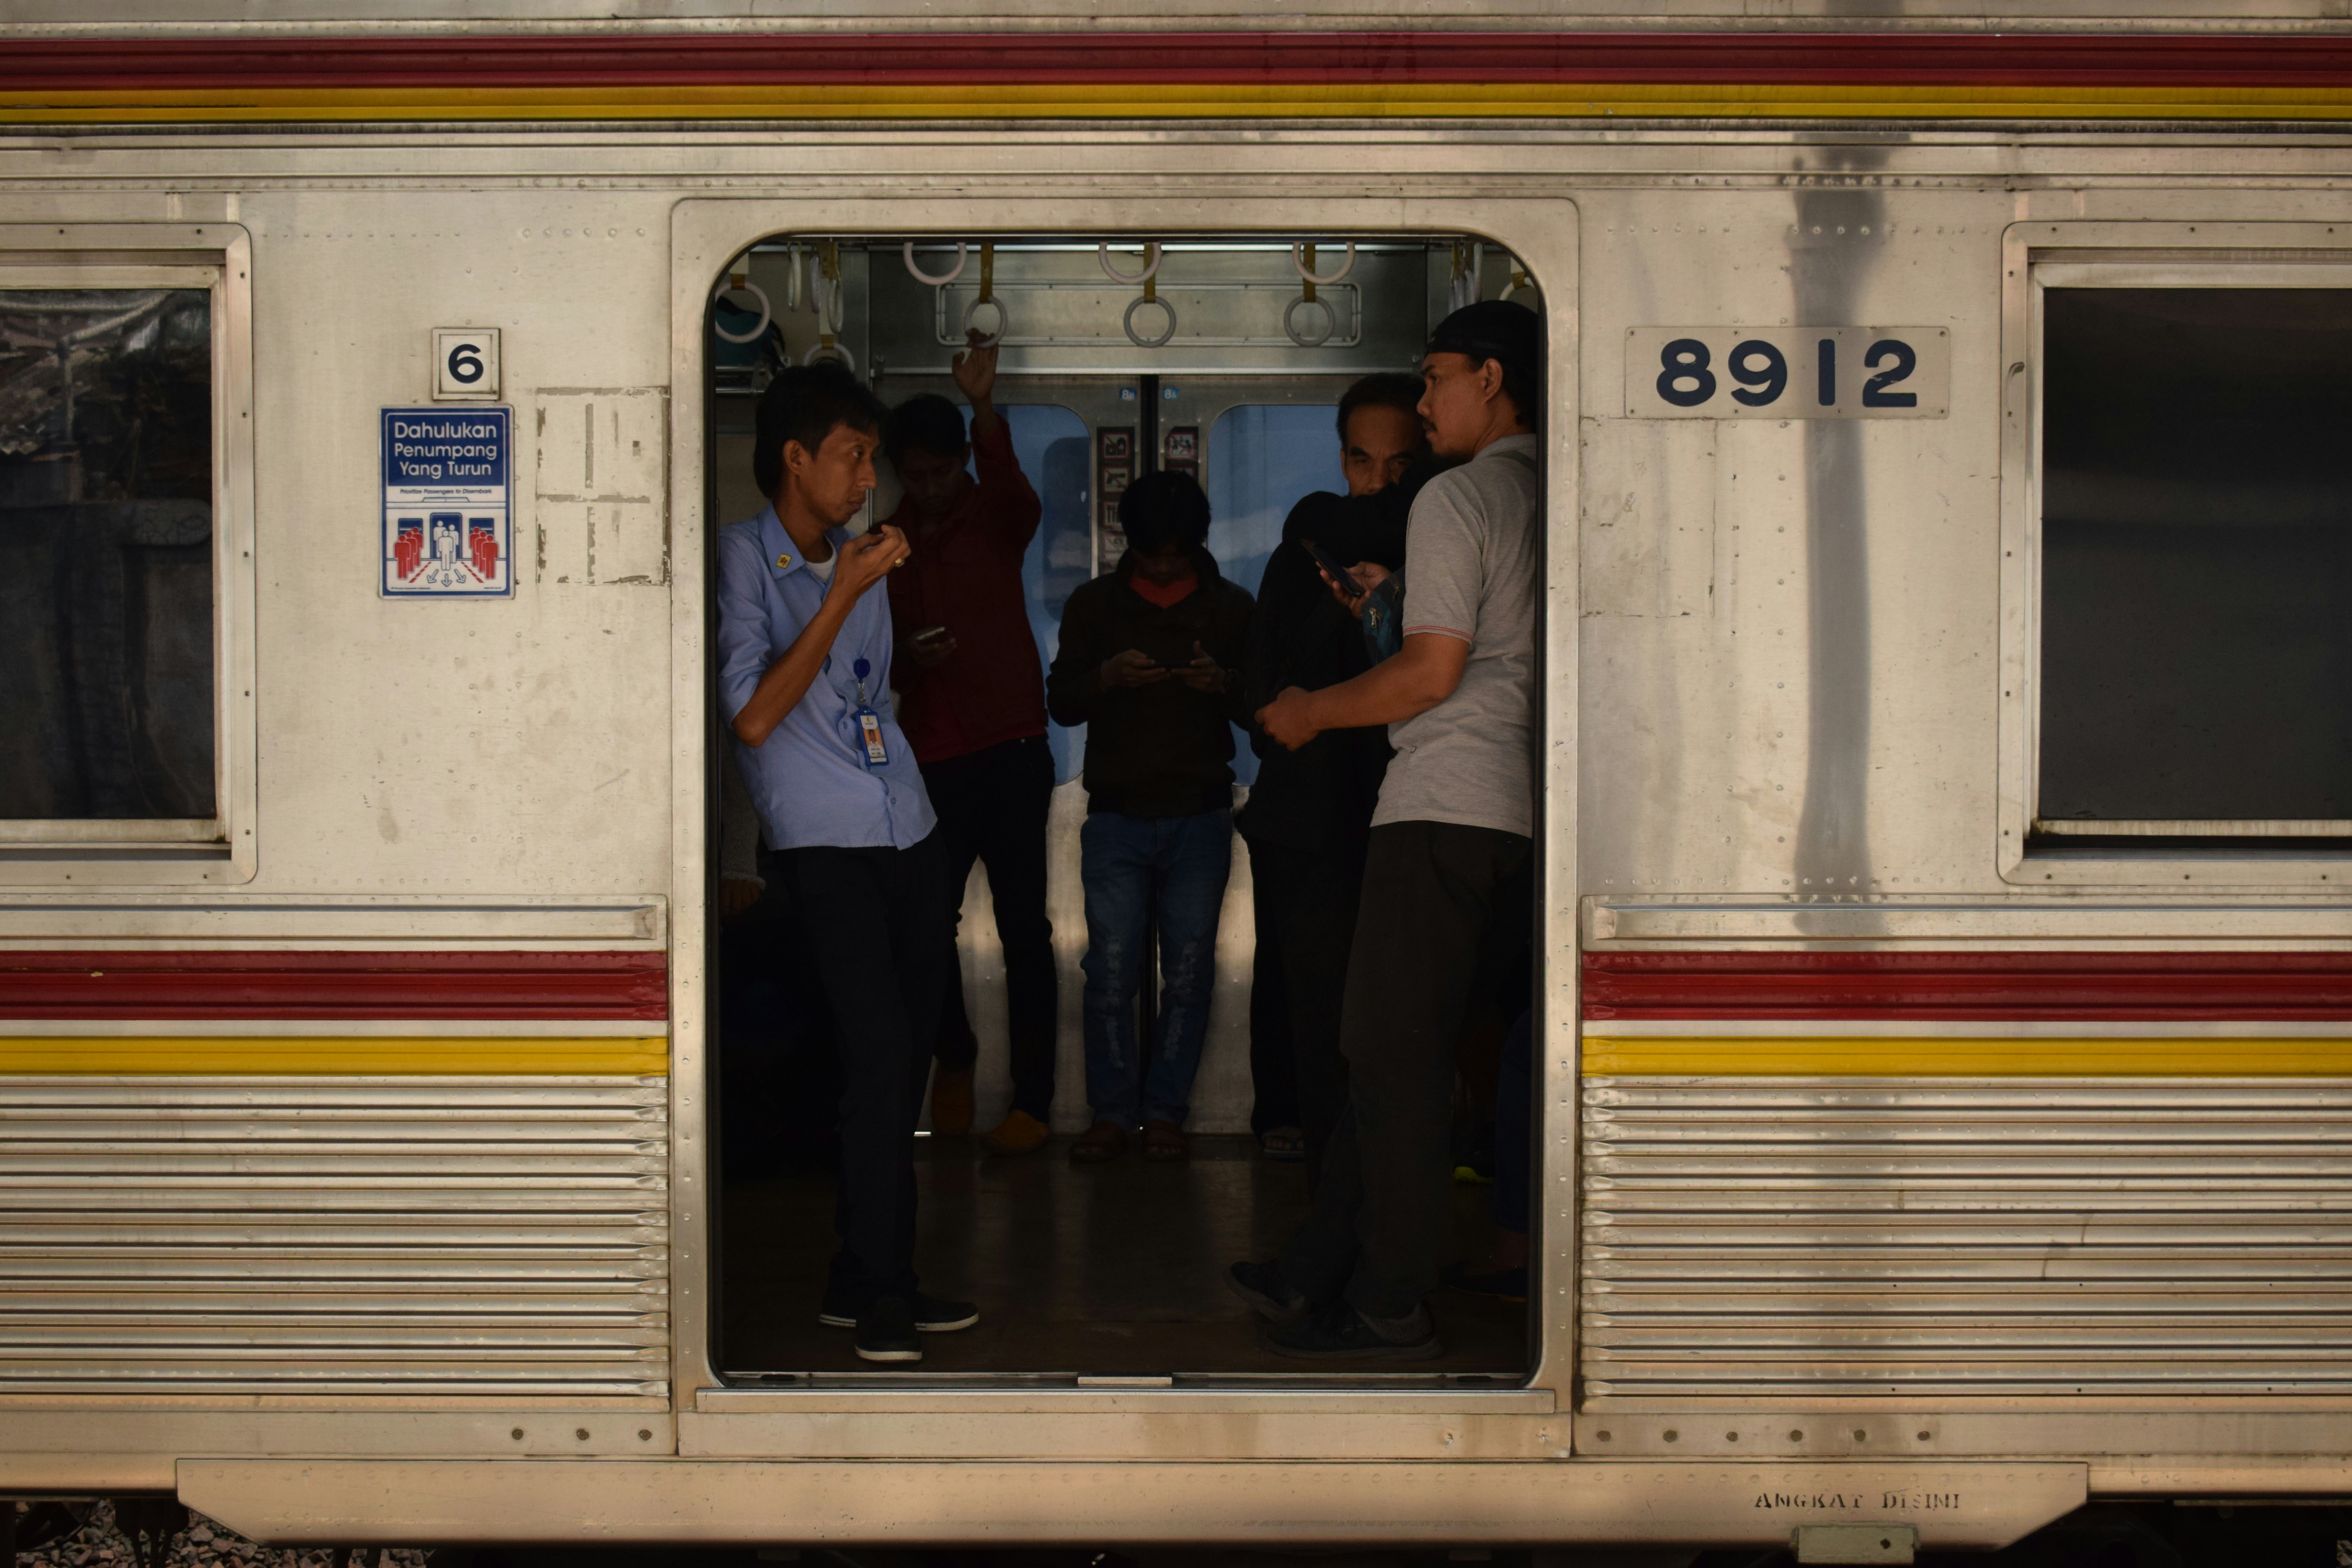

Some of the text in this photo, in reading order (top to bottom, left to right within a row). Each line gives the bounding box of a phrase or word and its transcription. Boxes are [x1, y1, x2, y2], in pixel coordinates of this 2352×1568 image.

[448, 344, 484, 384] 6
[1657, 339, 1917, 408] 8912
[1164, 389, 1176, 399] 8A
[395, 422, 497, 438] Dahulukan
[395, 443, 497, 460] Penumpang
[400, 462, 491, 479] Yang Turun
[1754, 1493, 1960, 1509] ANGKAT DISINI
